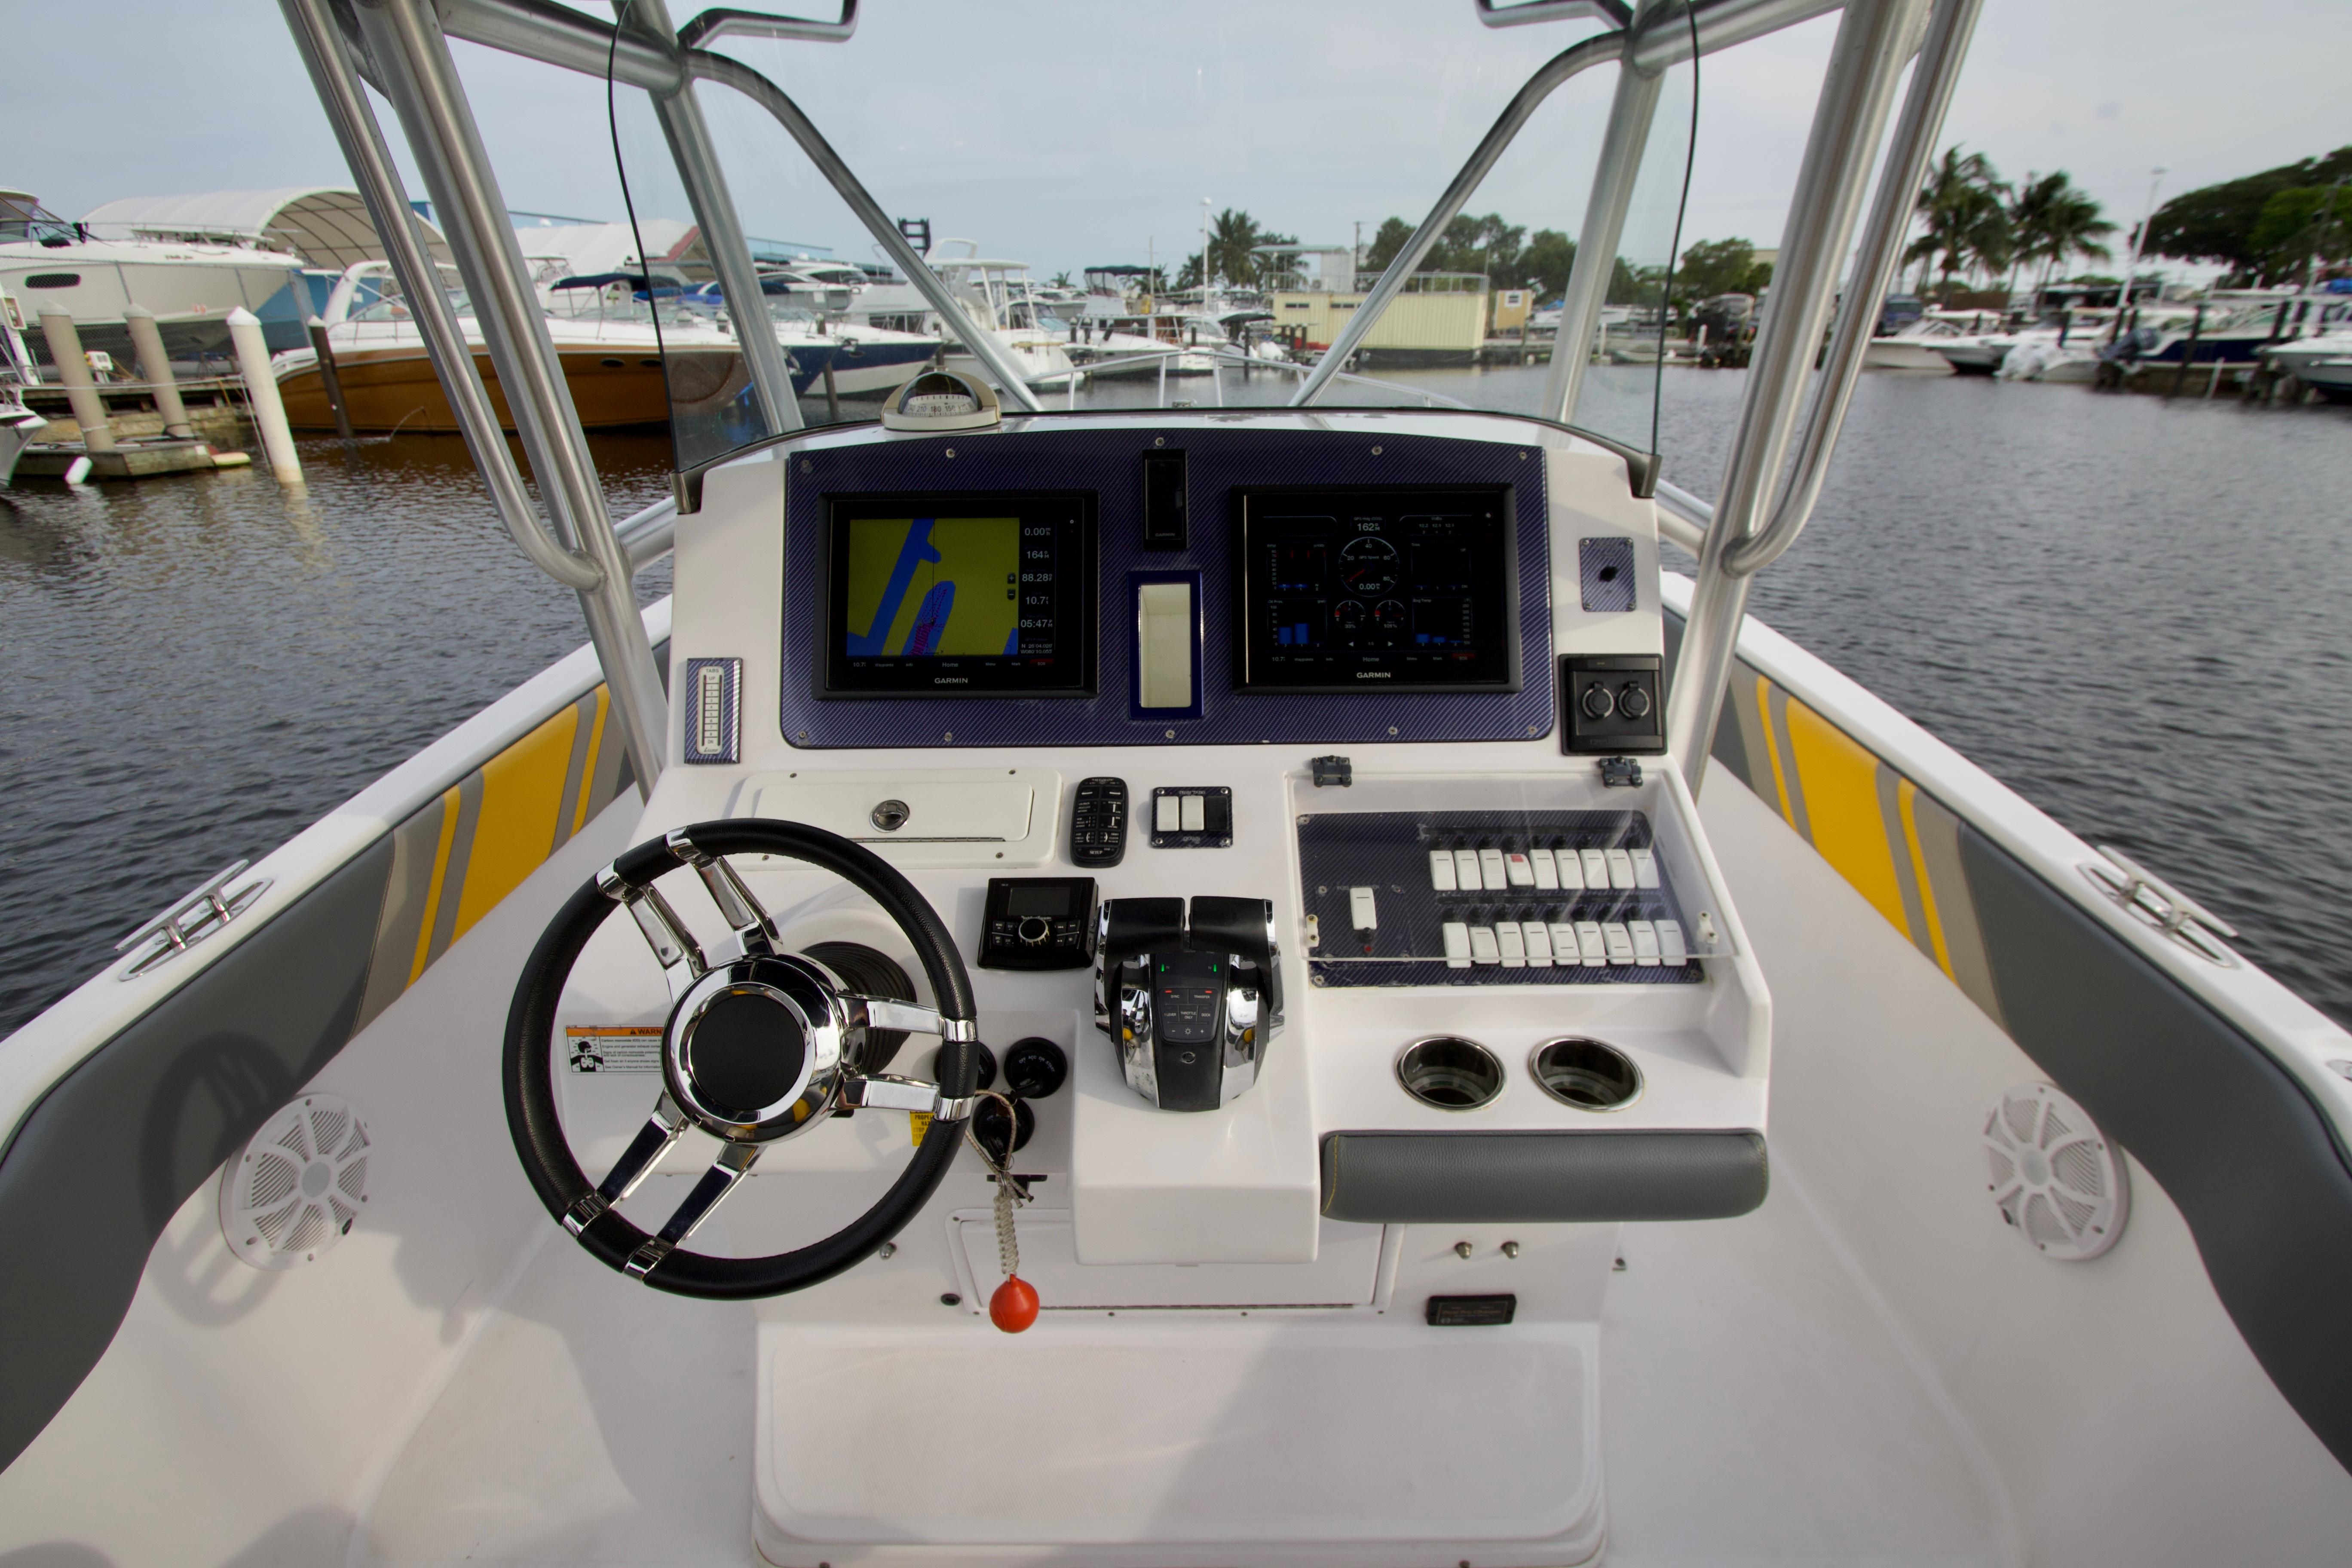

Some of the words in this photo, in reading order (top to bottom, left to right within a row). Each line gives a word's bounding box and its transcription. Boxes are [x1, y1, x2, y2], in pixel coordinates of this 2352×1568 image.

[1357, 523, 1375, 531] 162
[1026, 551, 1044, 559] 164
[1045, 1061, 1055, 1072] START
